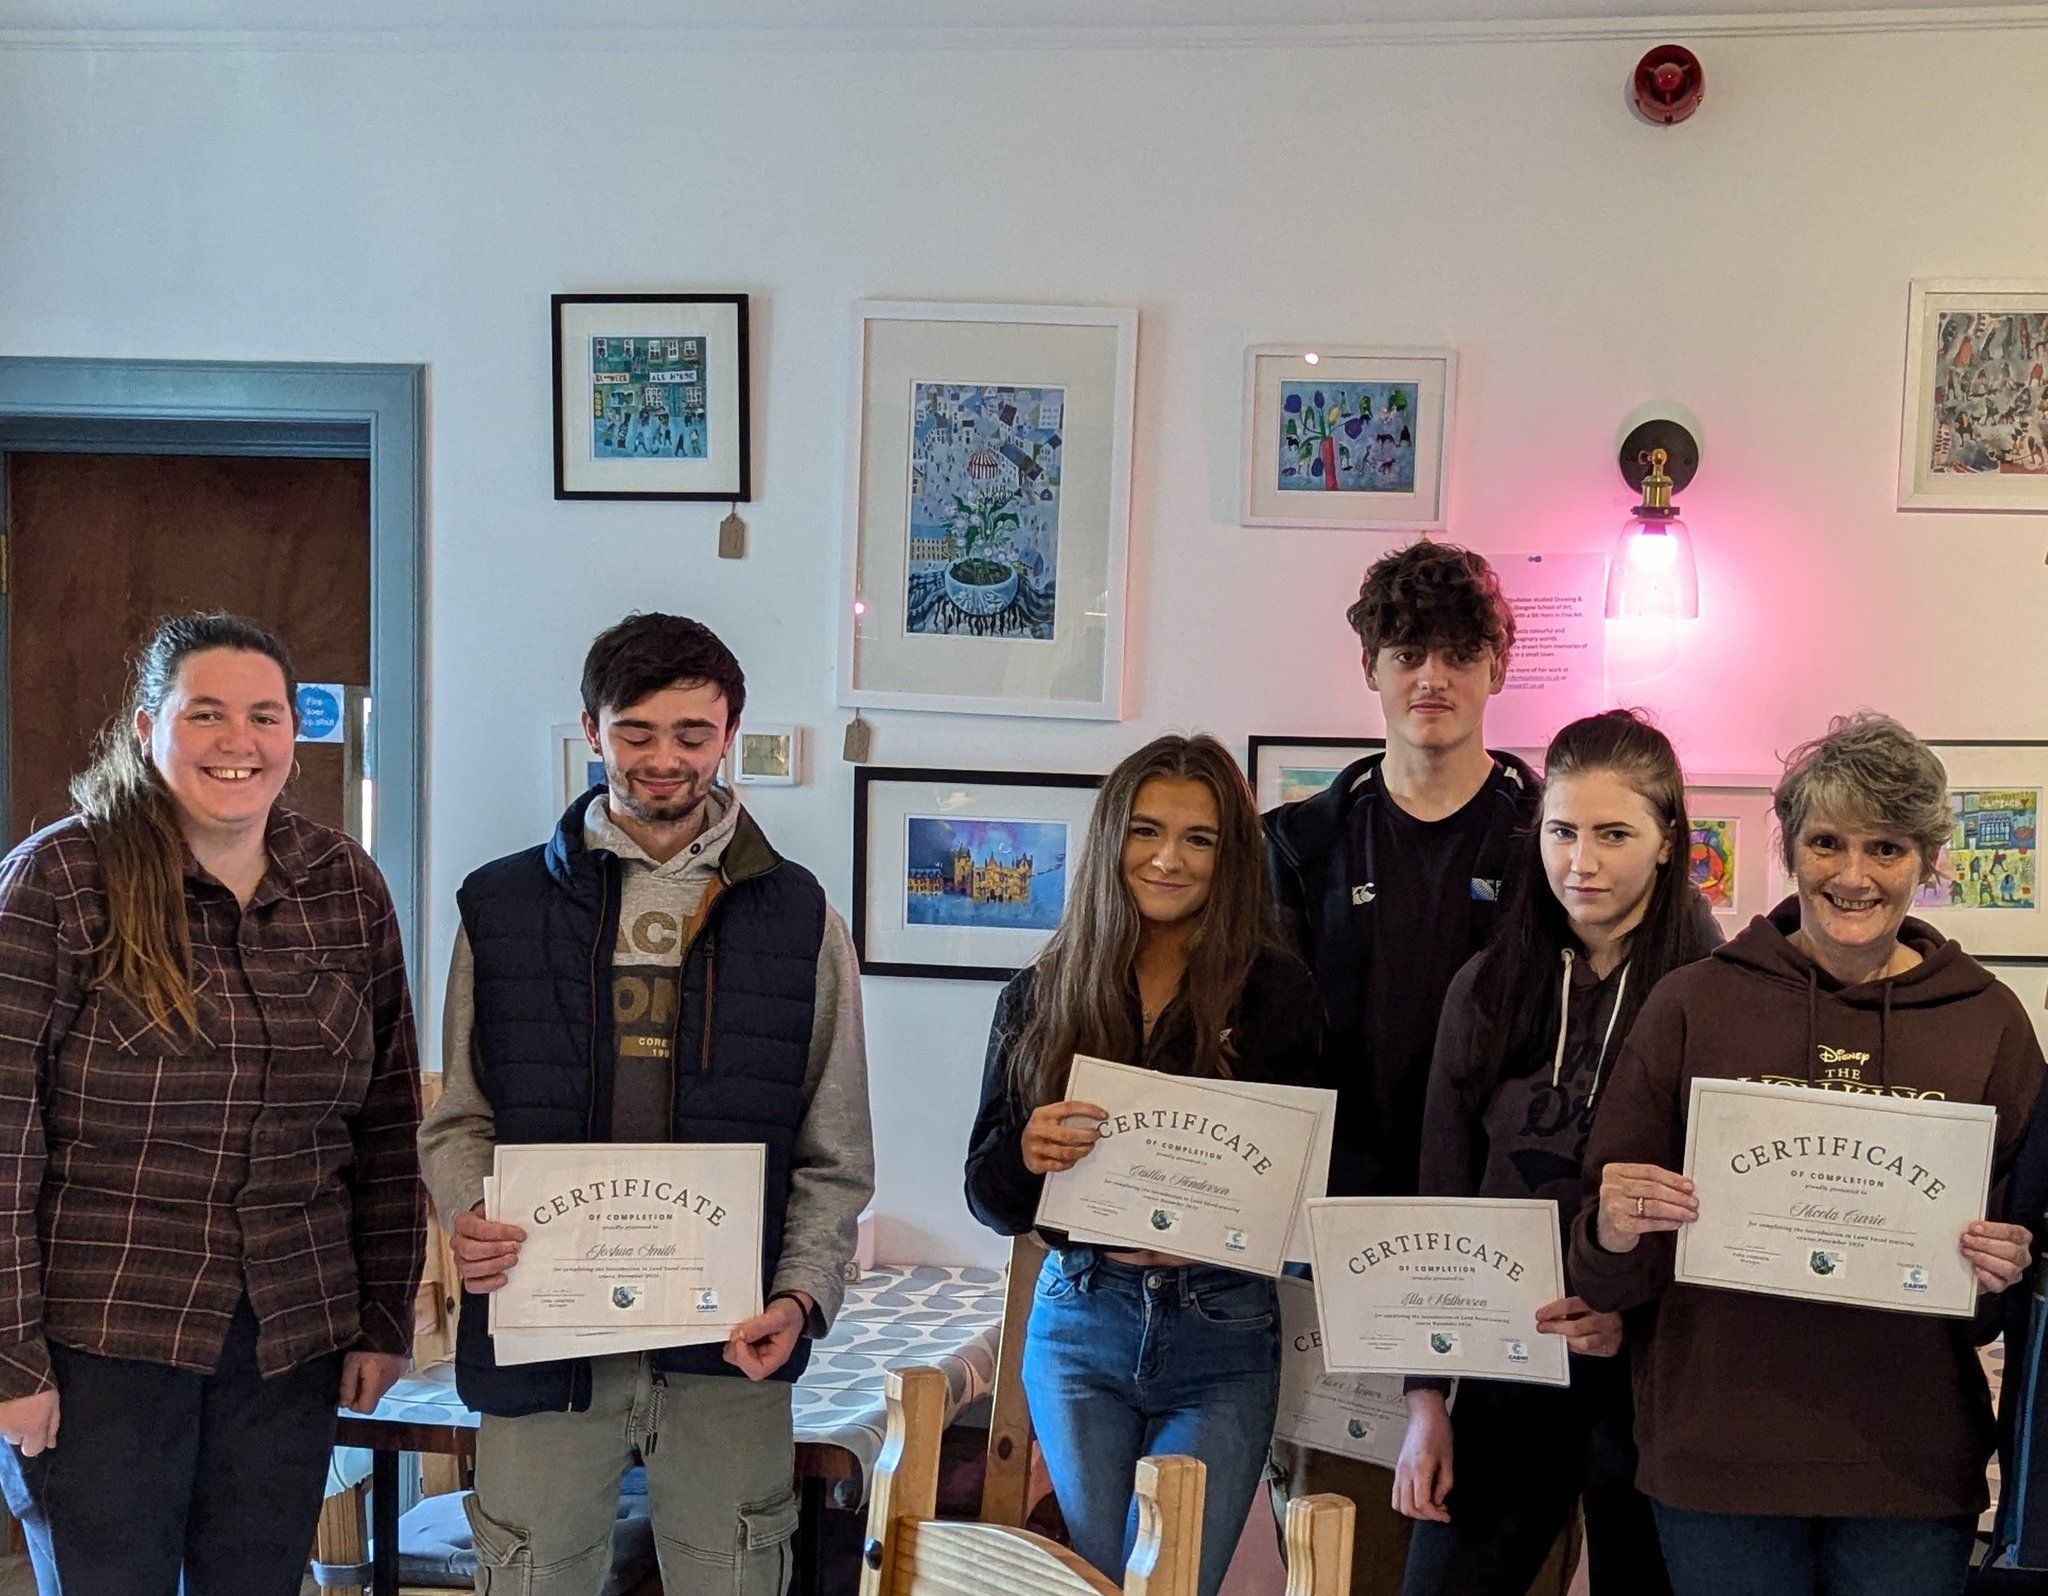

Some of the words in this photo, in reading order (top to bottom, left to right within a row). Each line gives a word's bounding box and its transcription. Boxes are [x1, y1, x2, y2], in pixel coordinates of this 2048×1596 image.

[639, 1036, 668, 1048] CORE
[1825, 1068, 1861, 1080] THE
[1097, 1110, 1272, 1176] CERTIFICATE
[1145, 1138, 1157, 1146] OF
[1161, 1141, 1222, 1160] COMPLETION
[1731, 1136, 1946, 1200] CERTIFICATE
[1790, 1169, 1804, 1177] OF
[1810, 1172, 1884, 1187] COMPLETION
[533, 1179, 727, 1227] CERTIFICATE
[1789, 1202, 1839, 1221] Nicola
[606, 1213, 672, 1221] COMPLETION
[1349, 1232, 1525, 1282] CERTIFICATE
